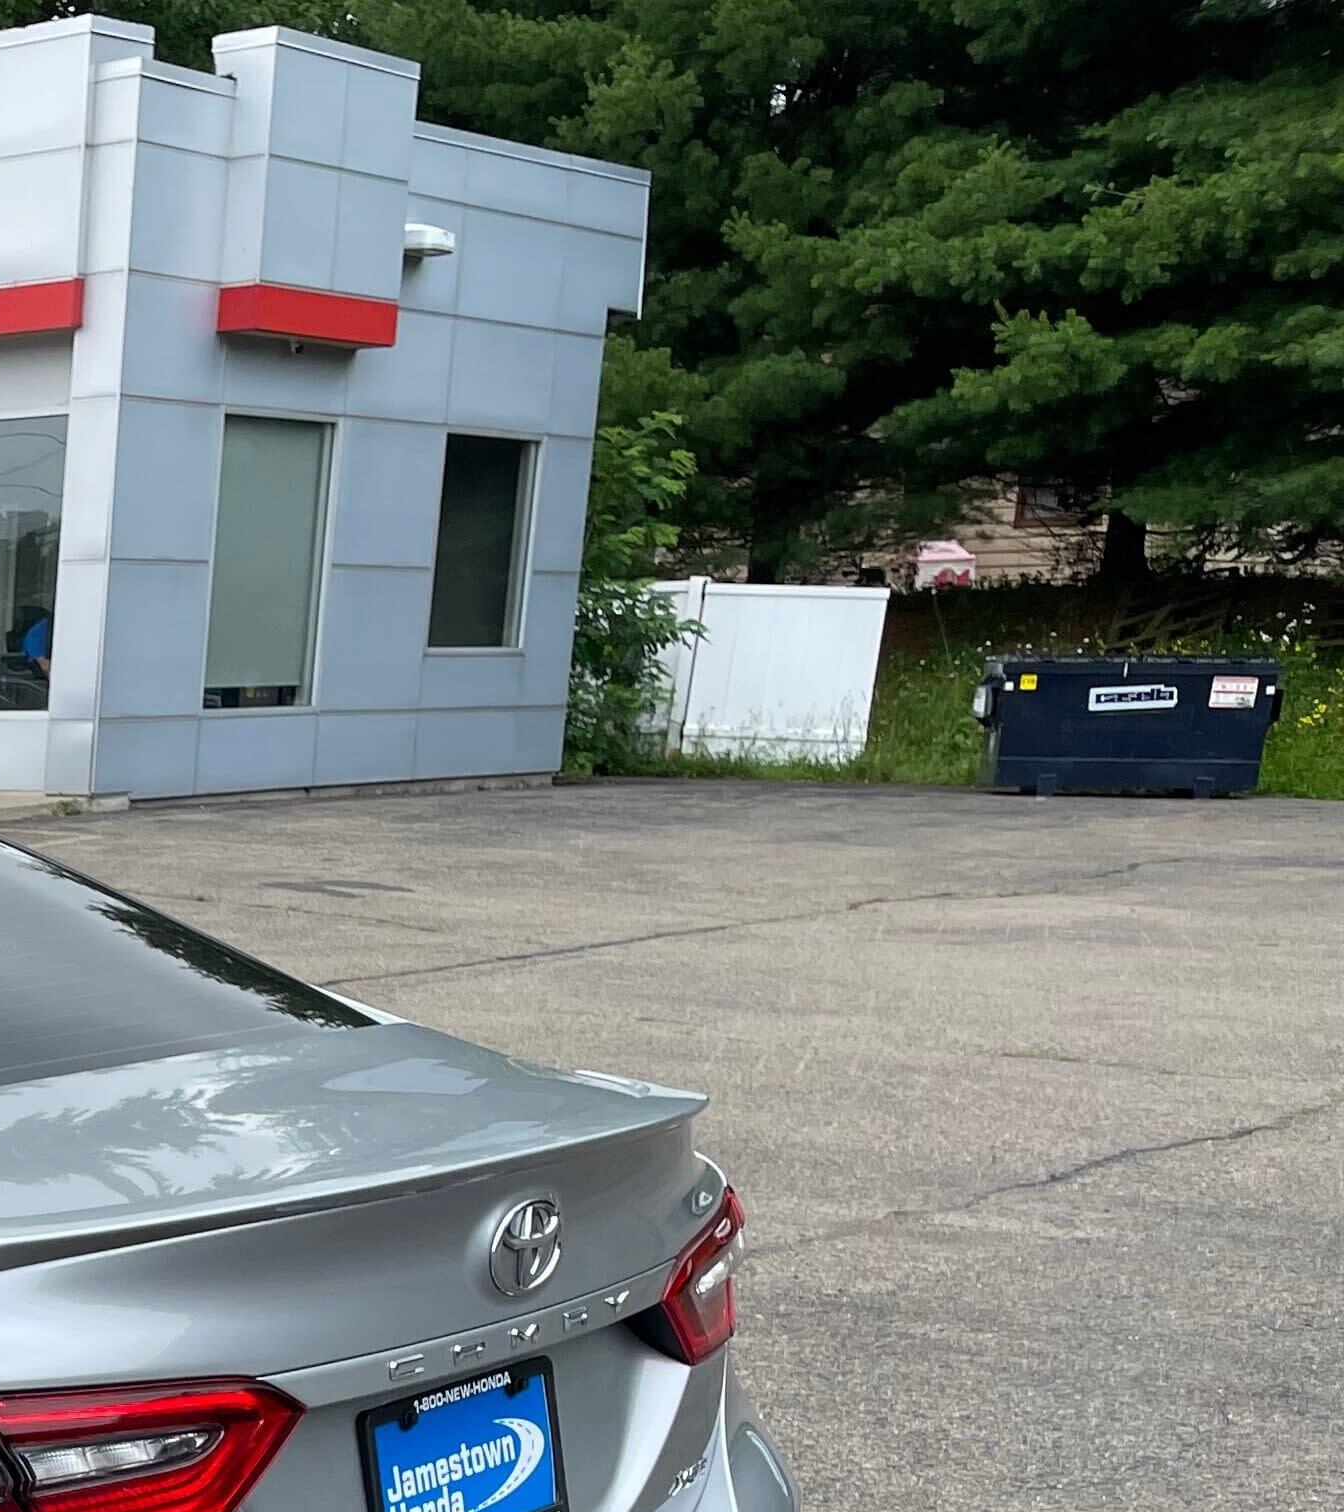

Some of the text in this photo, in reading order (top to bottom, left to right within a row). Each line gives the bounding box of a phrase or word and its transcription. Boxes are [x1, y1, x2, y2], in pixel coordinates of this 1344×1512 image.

[388, 1290, 630, 1382] CAMRY
[412, 1370, 512, 1415] 1-800-NEW-HONDA
[387, 1433, 516, 1502] Jamestown
